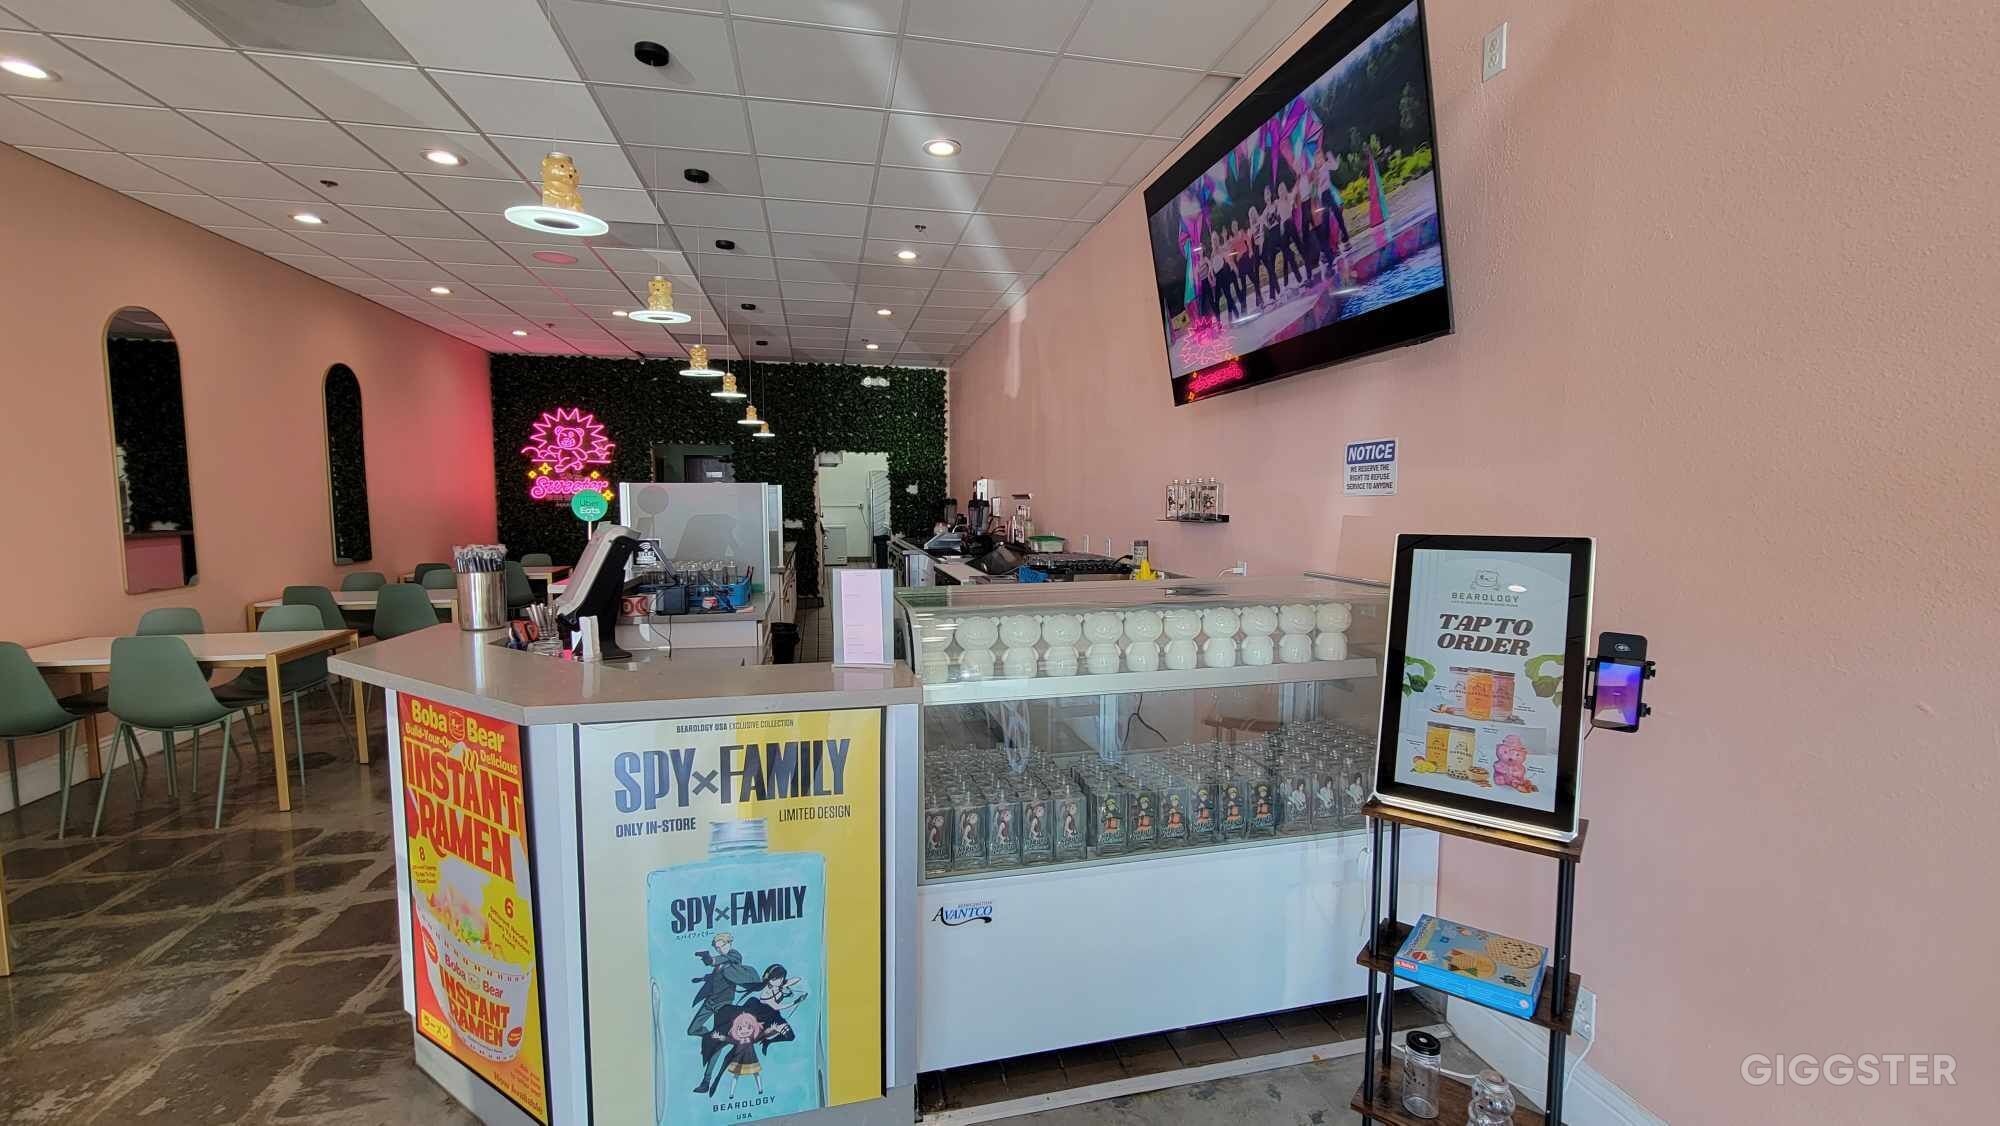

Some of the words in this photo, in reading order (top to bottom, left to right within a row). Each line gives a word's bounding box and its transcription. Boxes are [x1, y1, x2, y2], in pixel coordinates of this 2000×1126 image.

[1348, 443, 1394, 461] NOTICE
[580, 497, 599, 507] Uber
[580, 506, 600, 514] Eats
[1451, 592, 1519, 603] BEAROLOGY
[1439, 613, 1492, 632] TAP
[1495, 617, 1534, 636] TO
[1437, 633, 1531, 657] ORDER
[411, 699, 448, 733] Boba
[466, 717, 505, 753] Bear
[677, 723, 713, 733] BEAROLOGY
[714, 722, 727, 731] USA
[729, 721, 760, 730] EXCLUSIVE
[760, 719, 794, 728] COLLECTION
[480, 750, 519, 776] Delicious
[404, 737, 521, 835] INSTANT
[778, 807, 815, 823] LIMITED
[817, 805, 851, 820] DESIGN
[418, 791, 514, 883] RAMEN
[615, 820, 644, 838] ONLY
[646, 817, 696, 836] IN-STORE
[504, 897, 514, 918] 6
[445, 954, 467, 980] Boba
[482, 980, 504, 999] Bear
[439, 964, 511, 1028] INSTANT
[448, 1000, 504, 1048] RAMEN
[713, 1096, 776, 1112] BEAROLOGY
[736, 1112, 753, 1120] USA
